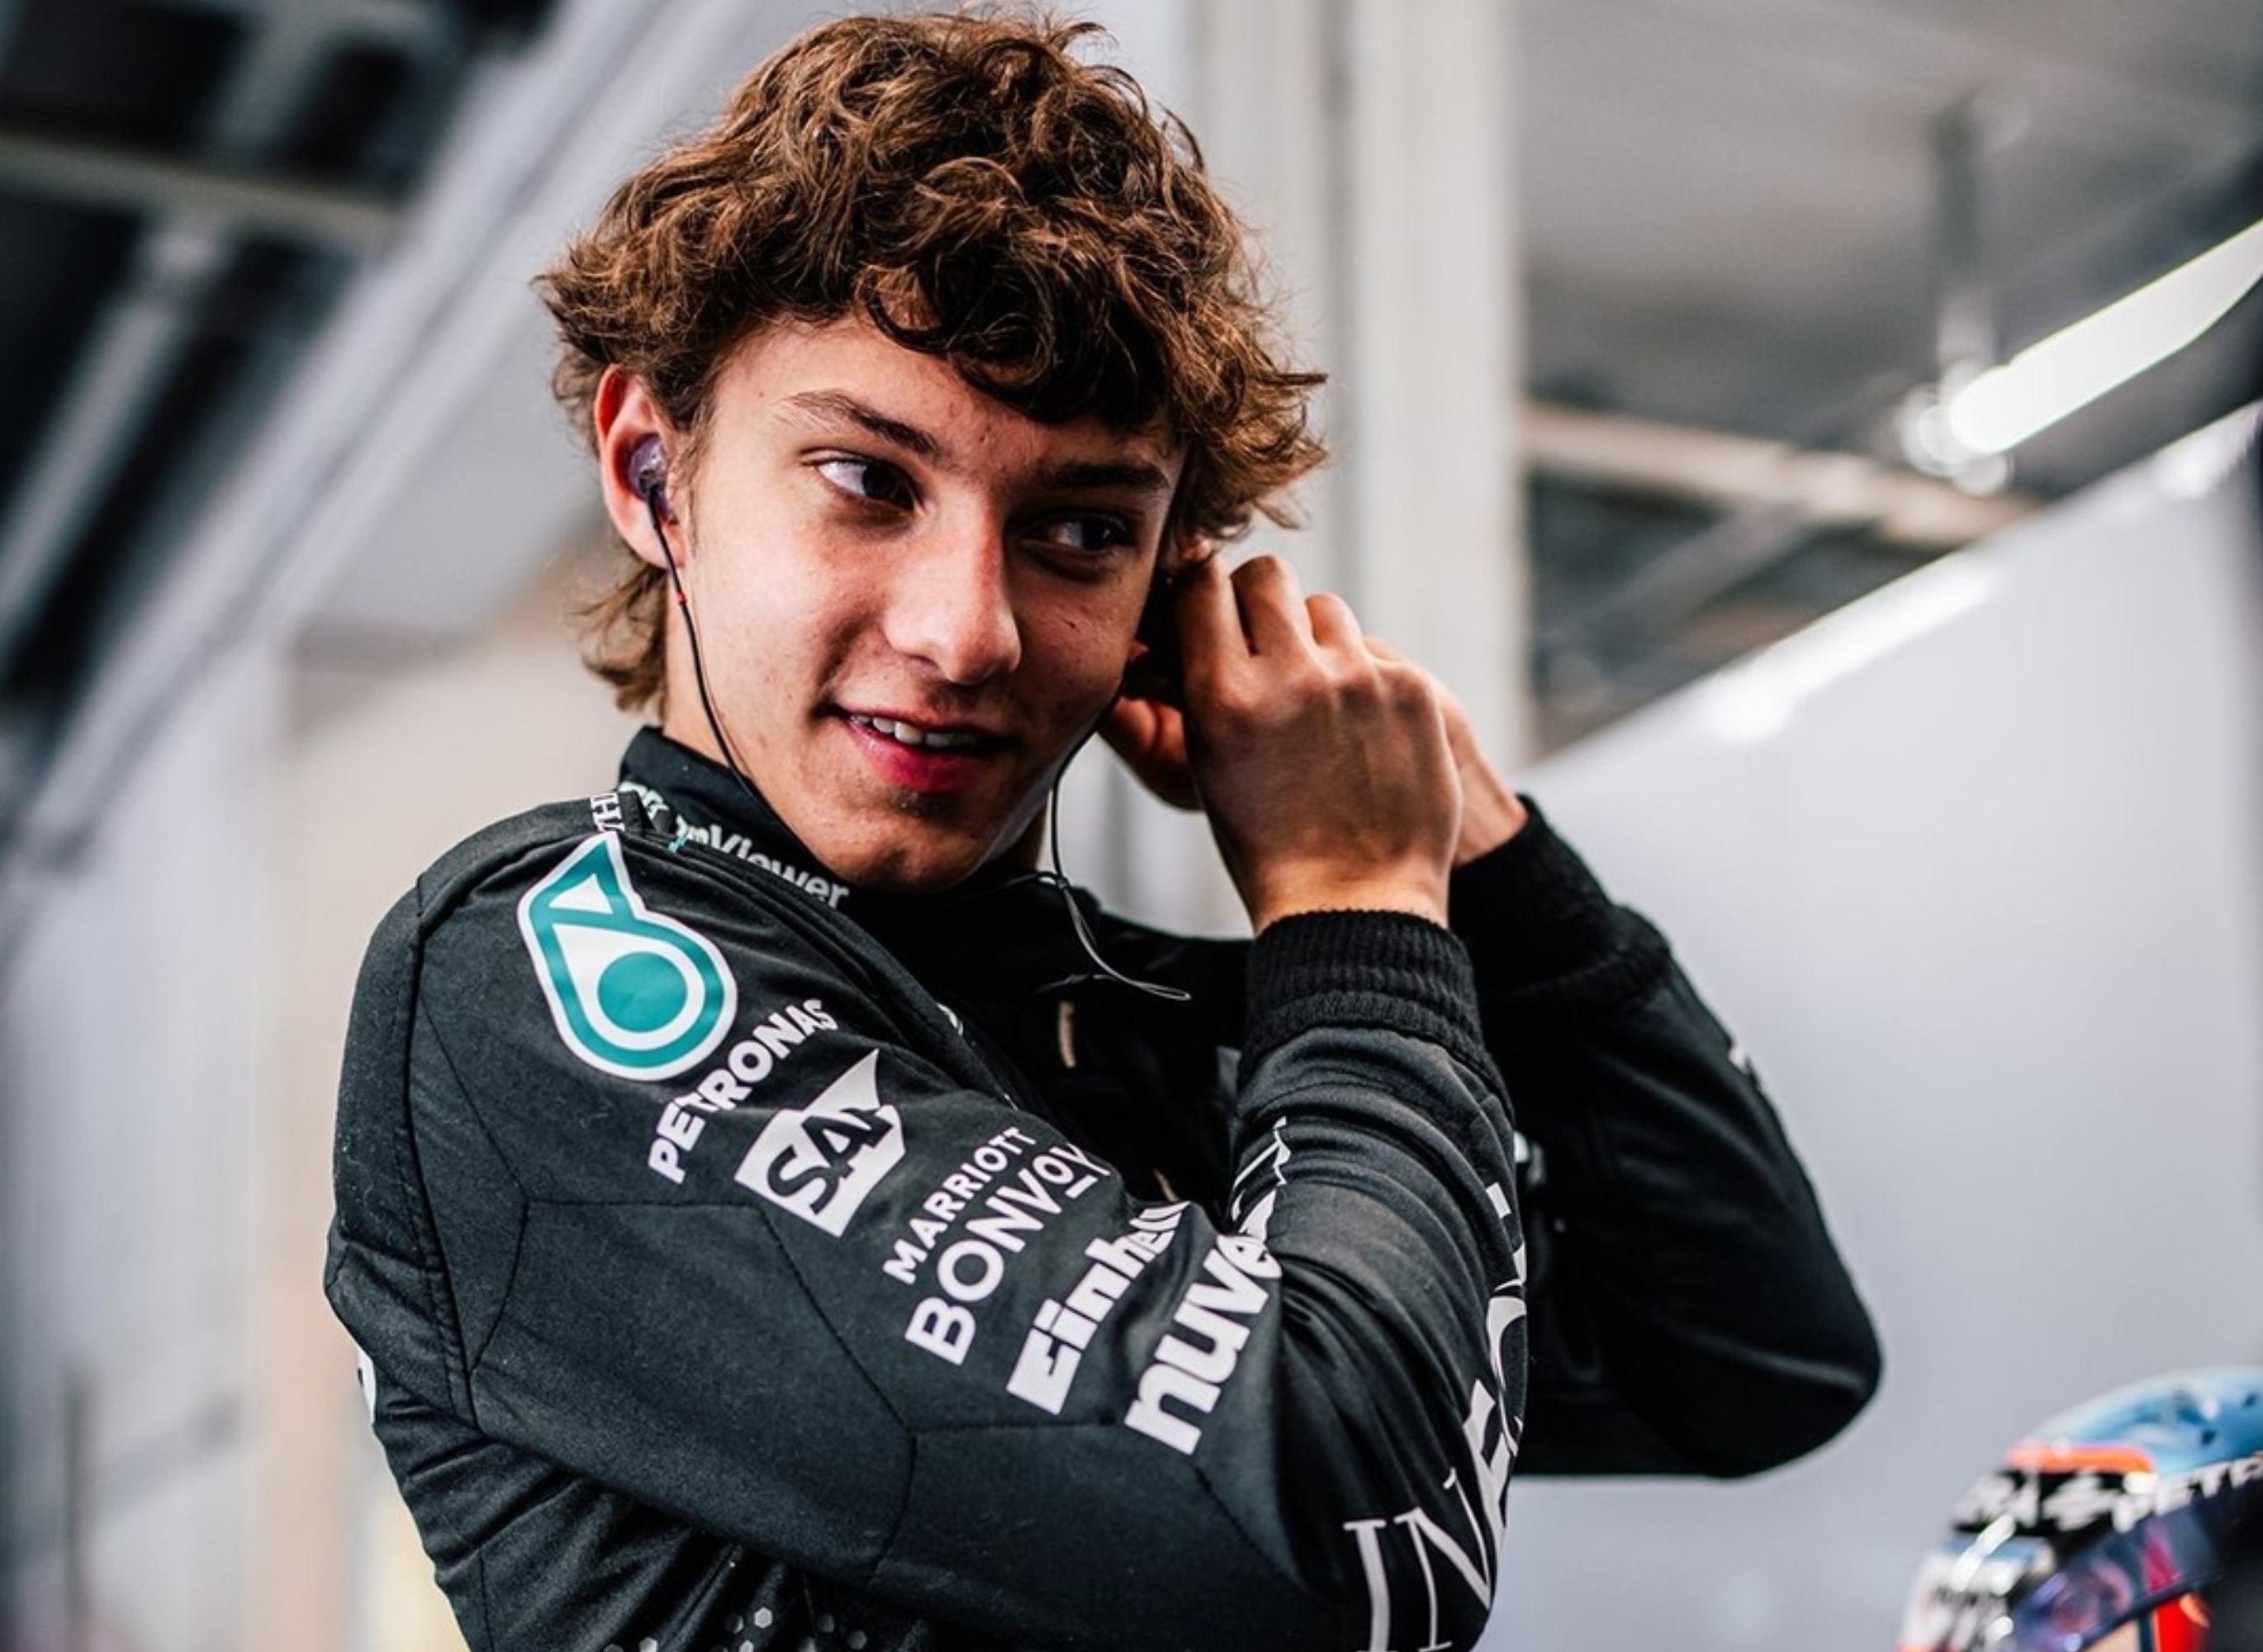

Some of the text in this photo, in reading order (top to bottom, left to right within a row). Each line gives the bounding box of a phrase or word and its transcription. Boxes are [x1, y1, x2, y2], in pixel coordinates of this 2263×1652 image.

[648, 999, 838, 1184] PETRONAS
[882, 1127, 1037, 1284] MARRIOTT
[904, 1142, 1111, 1366] BONVOY
